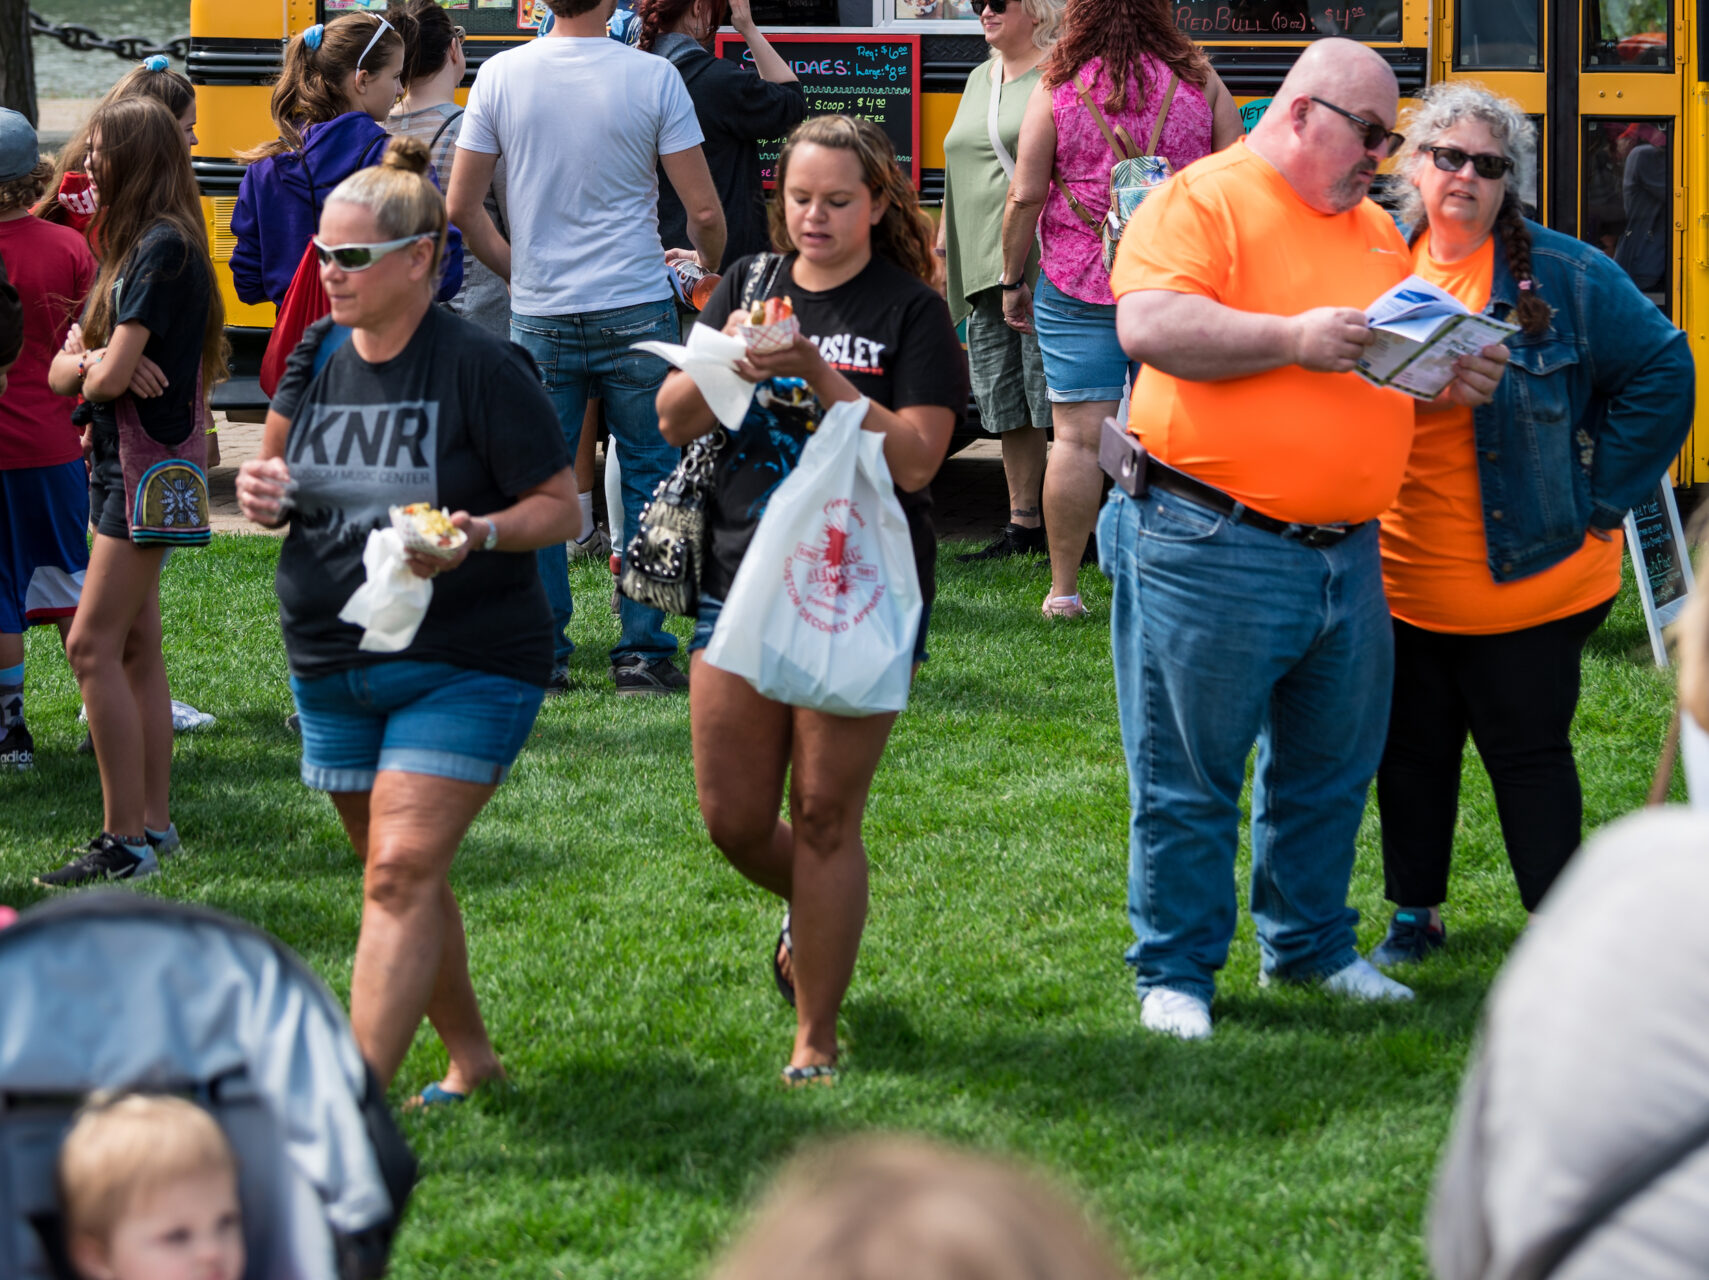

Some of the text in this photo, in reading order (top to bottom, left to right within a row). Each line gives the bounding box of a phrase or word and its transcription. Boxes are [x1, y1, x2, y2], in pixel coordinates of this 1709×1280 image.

[1215, 6, 1269, 32] BULL
[291, 406, 430, 468] KNR
[378, 471, 430, 485] CENTER
